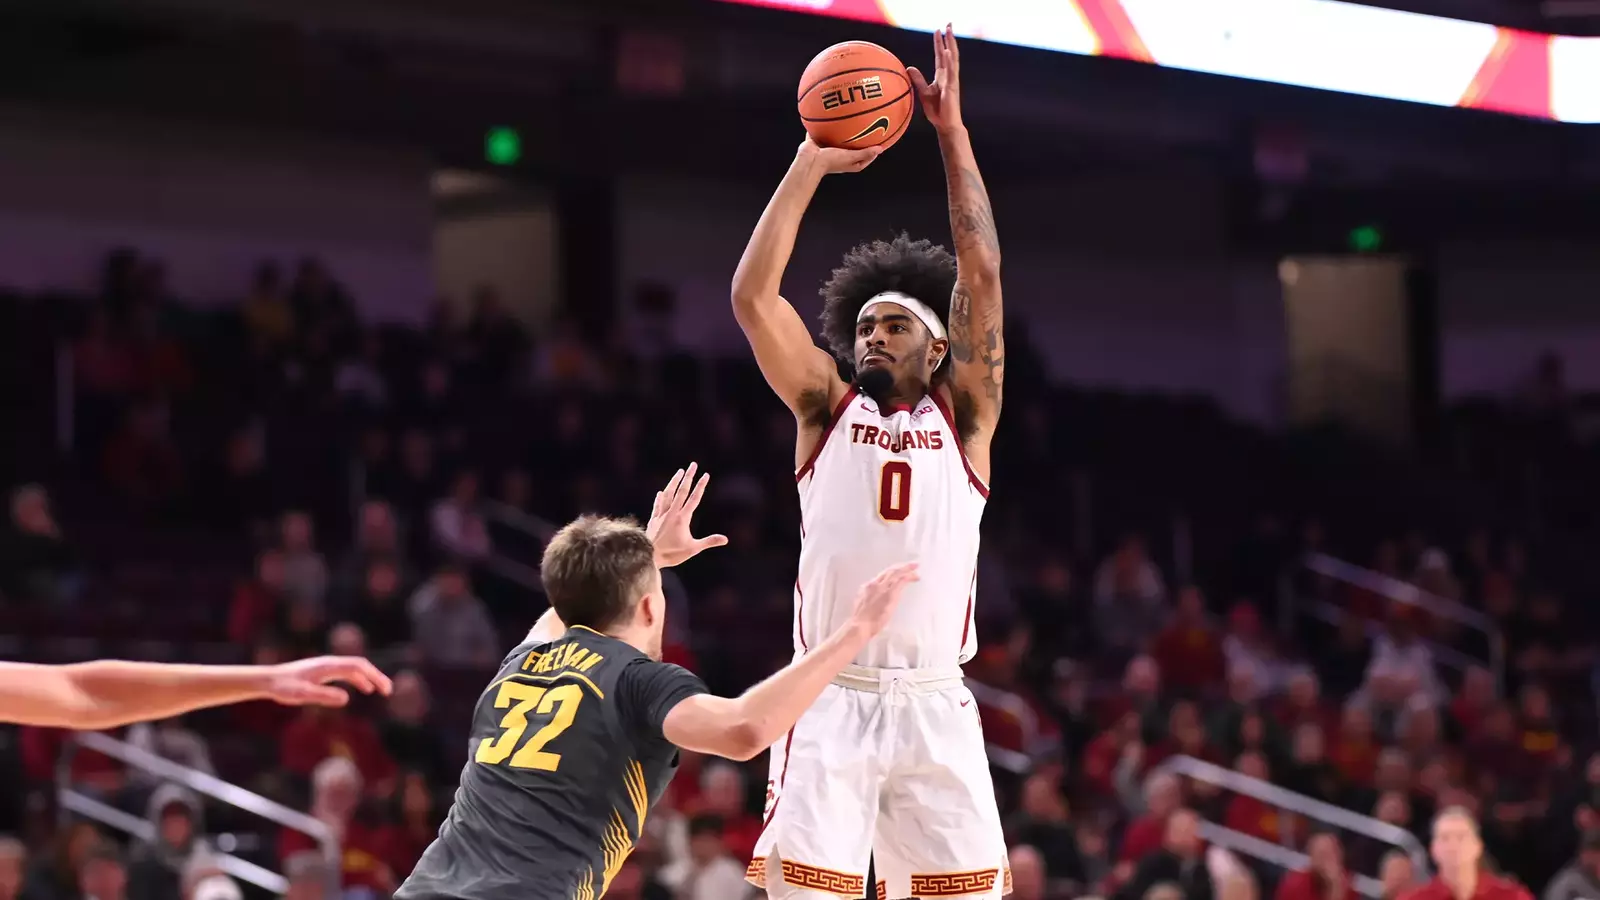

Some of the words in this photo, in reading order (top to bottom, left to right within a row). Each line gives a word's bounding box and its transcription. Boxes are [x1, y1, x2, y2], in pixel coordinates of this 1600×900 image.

[821, 82, 883, 110] ELITE
[851, 423, 943, 453] TROJANS
[878, 460, 912, 522] 0
[475, 681, 584, 772] 32
